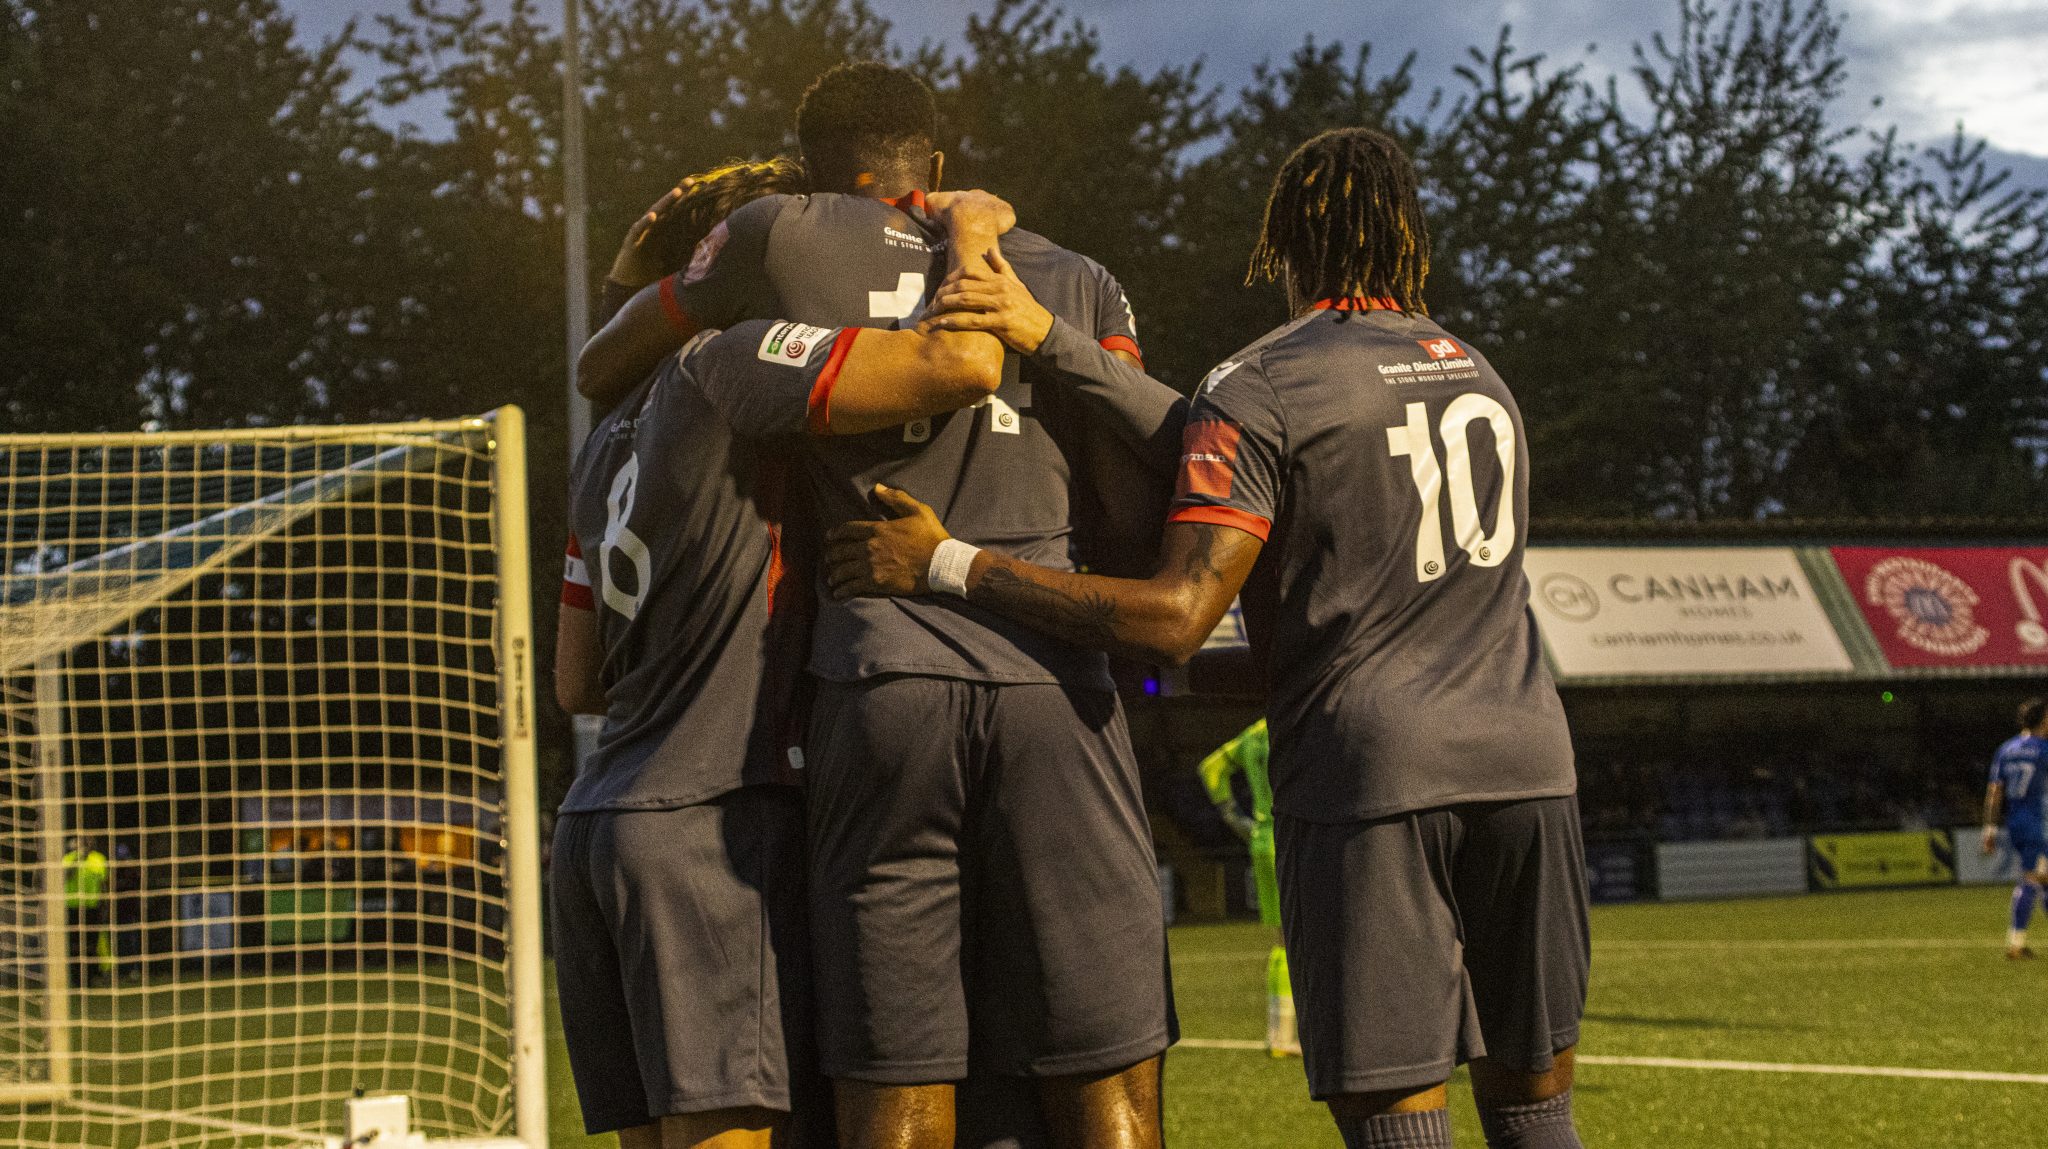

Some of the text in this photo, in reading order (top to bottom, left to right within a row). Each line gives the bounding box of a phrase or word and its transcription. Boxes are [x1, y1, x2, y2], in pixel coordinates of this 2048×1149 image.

[884, 226, 924, 244] Granite
[885, 238, 898, 247] THE
[901, 241, 923, 251] STONE
[1429, 339, 1457, 359] gdl
[1378, 357, 1476, 375] Granite Direct Limited
[1398, 376, 1417, 384] STONE
[1418, 374, 1445, 382] WORKTOP
[1447, 370, 1480, 380] SPECIALIST
[1386, 393, 1516, 584] 10
[600, 451, 650, 622] 8
[1607, 573, 1800, 602] CANHAM
